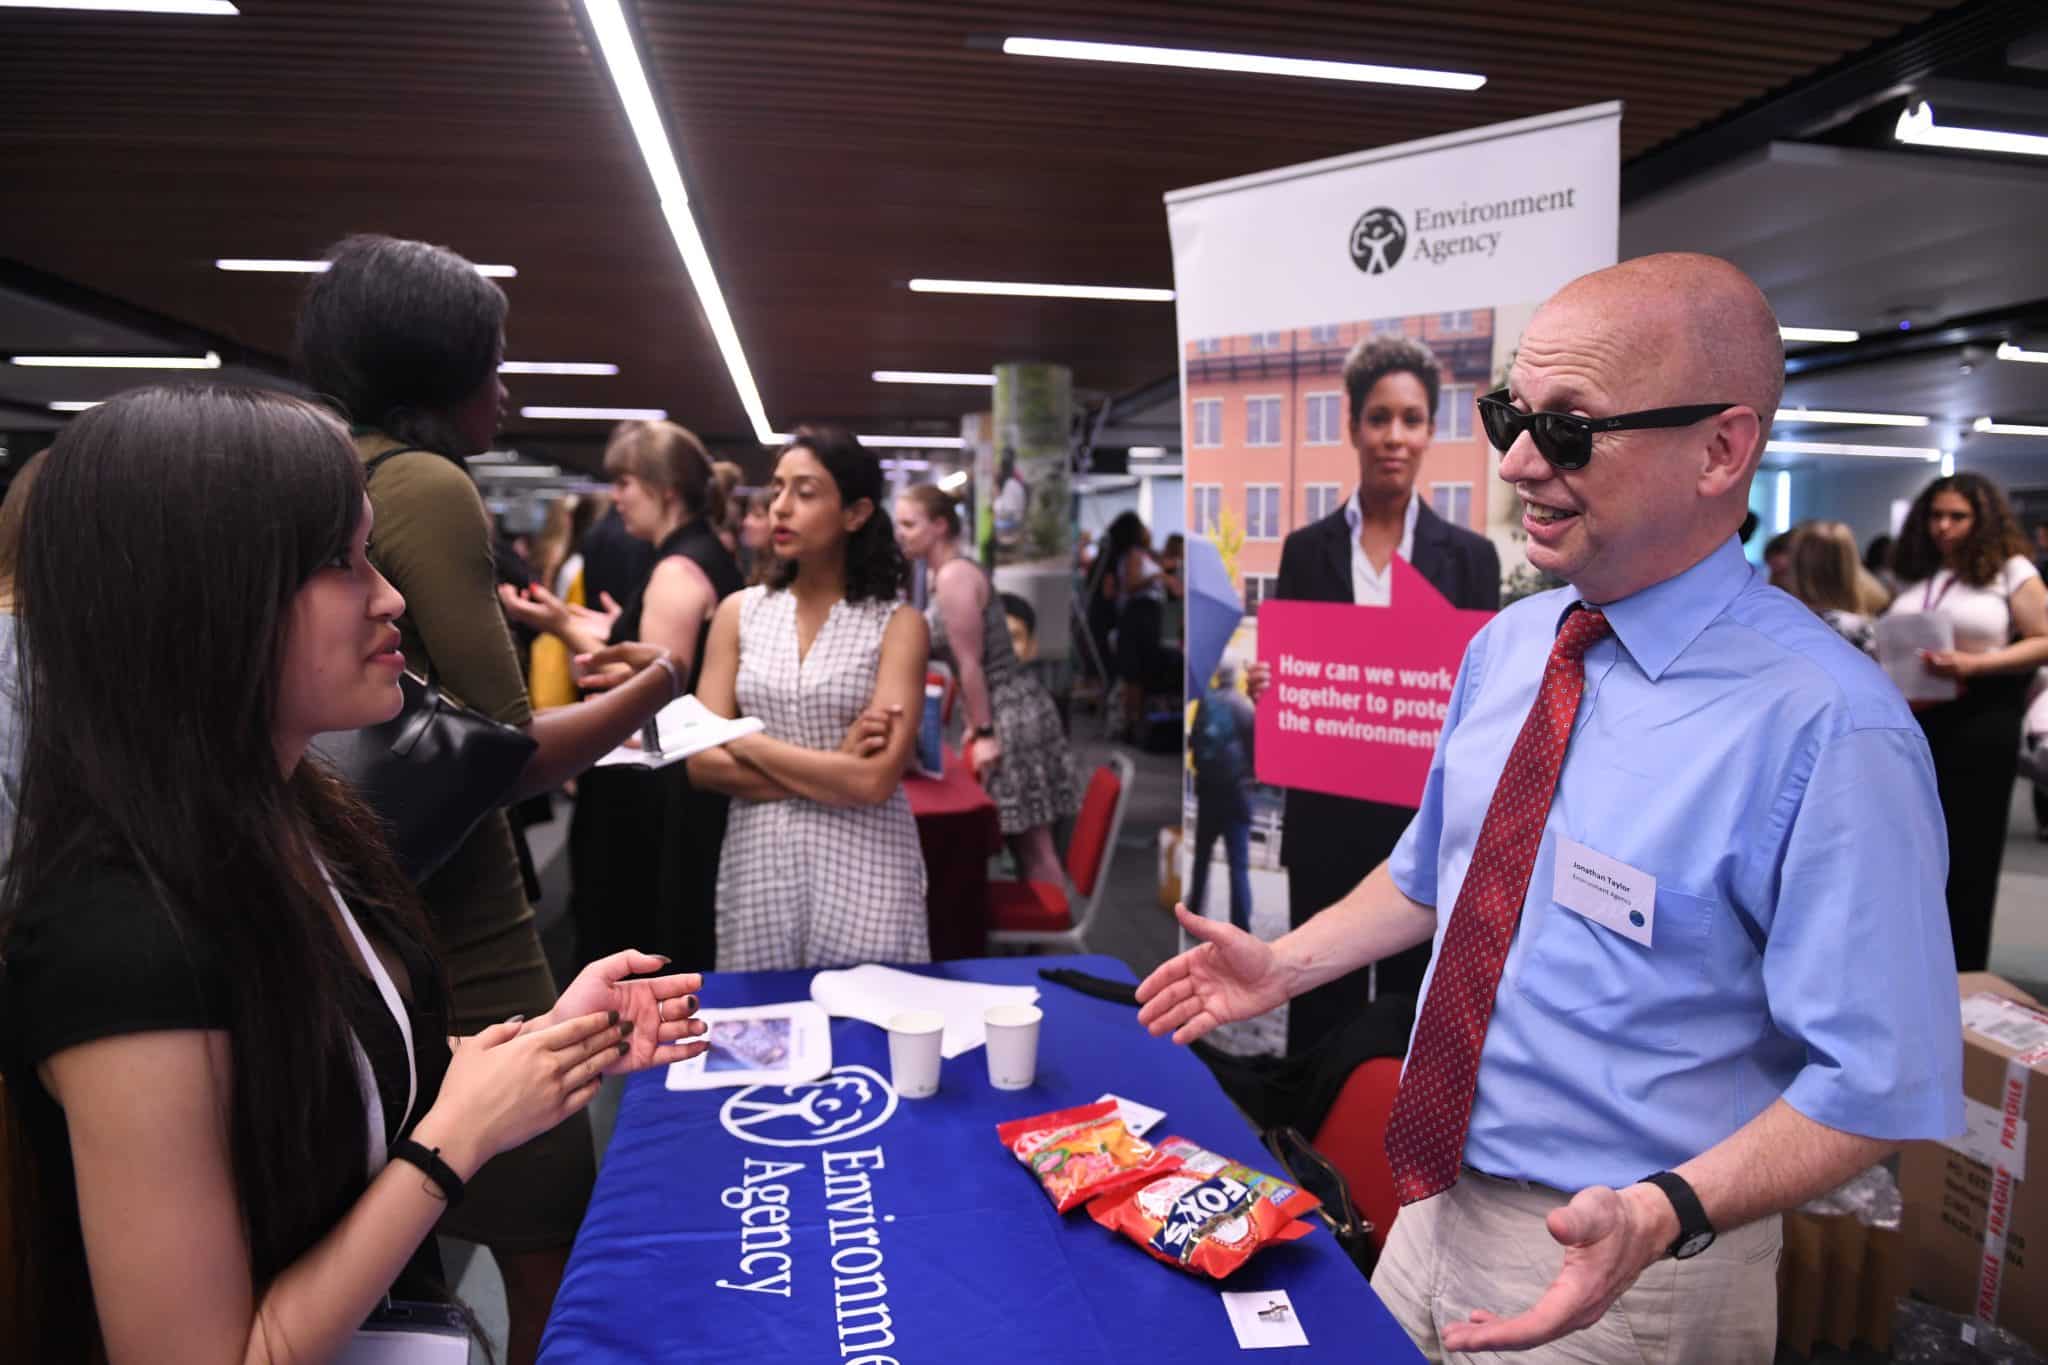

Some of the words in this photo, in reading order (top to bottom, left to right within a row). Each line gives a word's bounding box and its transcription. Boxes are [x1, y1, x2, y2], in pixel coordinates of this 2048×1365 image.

[1414, 187, 1576, 232] Environment
[1413, 231, 1502, 264] Agency
[1279, 654, 1321, 679] How
[1325, 662, 1359, 682] can
[1364, 667, 1394, 686] we
[1399, 667, 1452, 691] work
[1278, 683, 1360, 711] together
[1366, 692, 1388, 714] to
[1278, 710, 1311, 733] the
[1572, 861, 1606, 881] Jonathan
[1607, 876, 1631, 893] Taylor
[2000, 1078, 2024, 1150] FRAGILE
[1989, 1164, 2012, 1237] FRAGILE
[715, 1157, 805, 1297] Agency
